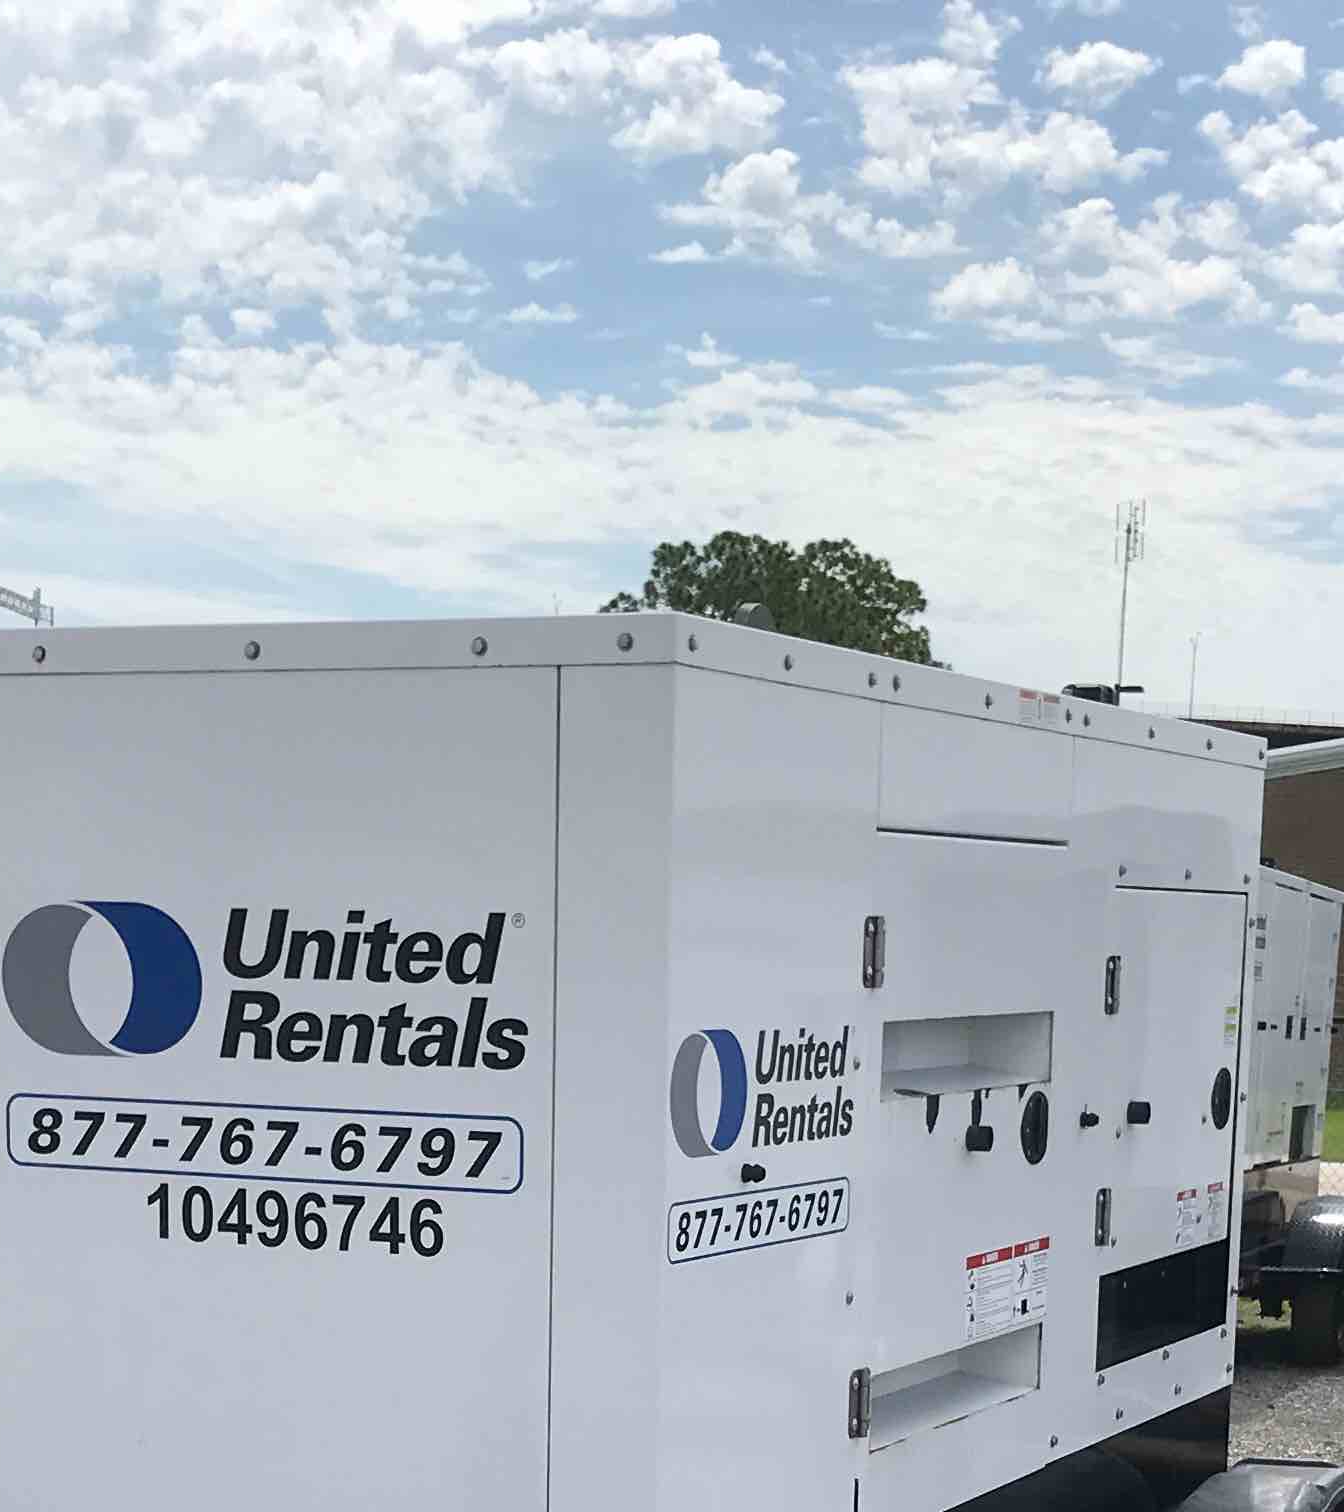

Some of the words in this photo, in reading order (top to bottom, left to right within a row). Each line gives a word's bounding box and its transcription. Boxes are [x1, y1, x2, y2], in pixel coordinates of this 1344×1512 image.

[223, 908, 506, 985] United
[219, 990, 529, 1071] Rentals
[755, 1025, 849, 1084] United
[27, 1108, 502, 1180] 877-767-6797
[752, 1086, 854, 1148] Rentals
[146, 1183, 445, 1257] 10496746
[675, 1188, 844, 1252] 877-767-6797
